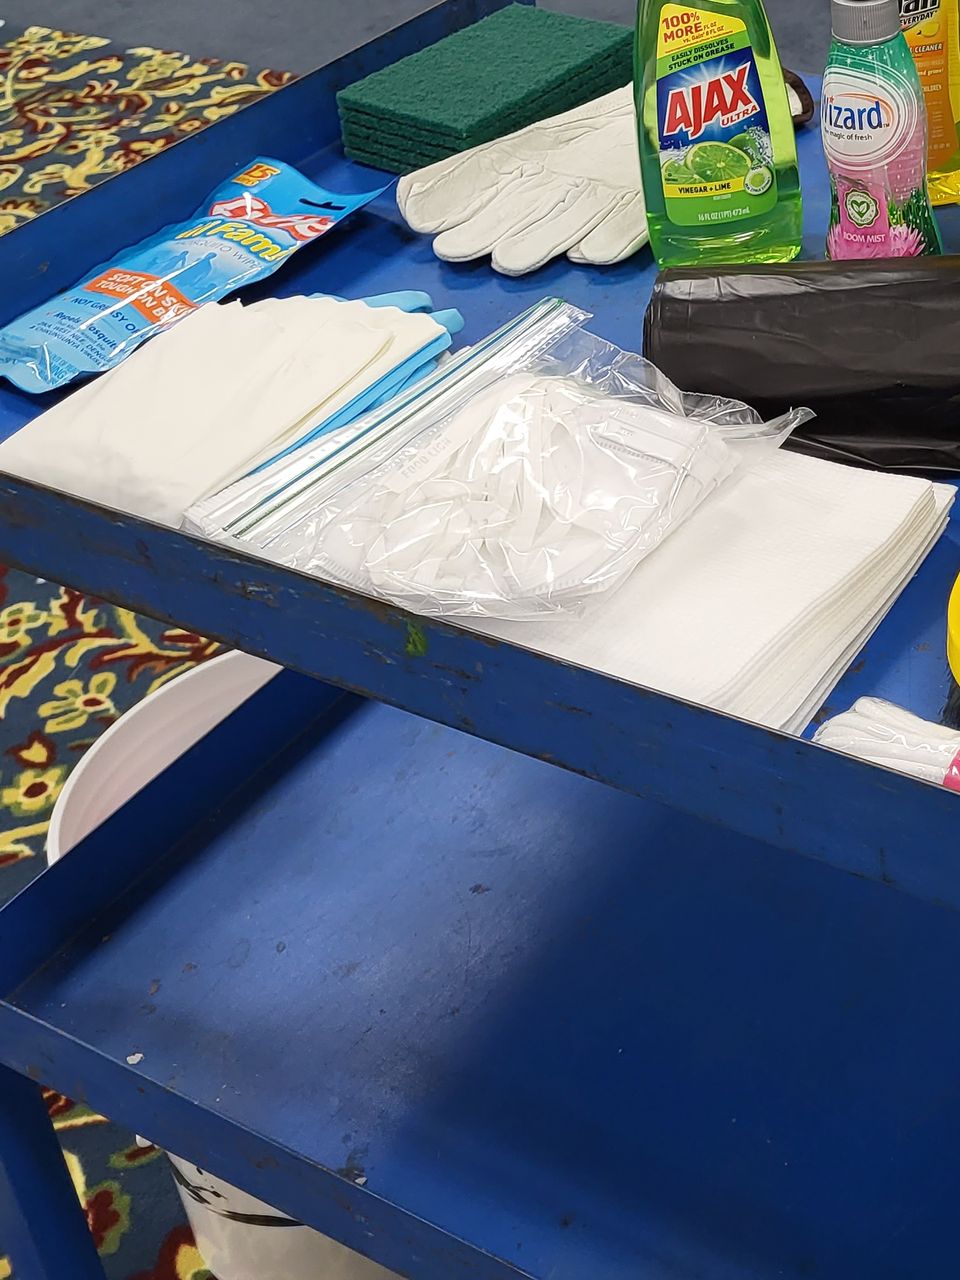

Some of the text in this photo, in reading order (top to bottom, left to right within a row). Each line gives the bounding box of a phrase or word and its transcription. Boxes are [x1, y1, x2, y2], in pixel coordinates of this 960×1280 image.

[661, 11, 700, 30] 100%
[663, 21, 704, 44] MORE
[668, 42, 736, 71] STUCK ON GREASE
[671, 38, 730, 62] EASILY DISSOLVES
[914, 43, 943, 53] CLEANER
[663, 61, 755, 140] AJAX
[721, 104, 759, 127] ULTRA
[830, 131, 846, 140] magic
[854, 133, 873, 141] fresh
[677, 185, 708, 194] VINEGAR
[714, 182, 732, 191] LIME
[866, 234, 886, 243] MIST
[96, 280, 138, 296] TOUGH
[109, 272, 145, 287] SOFT
